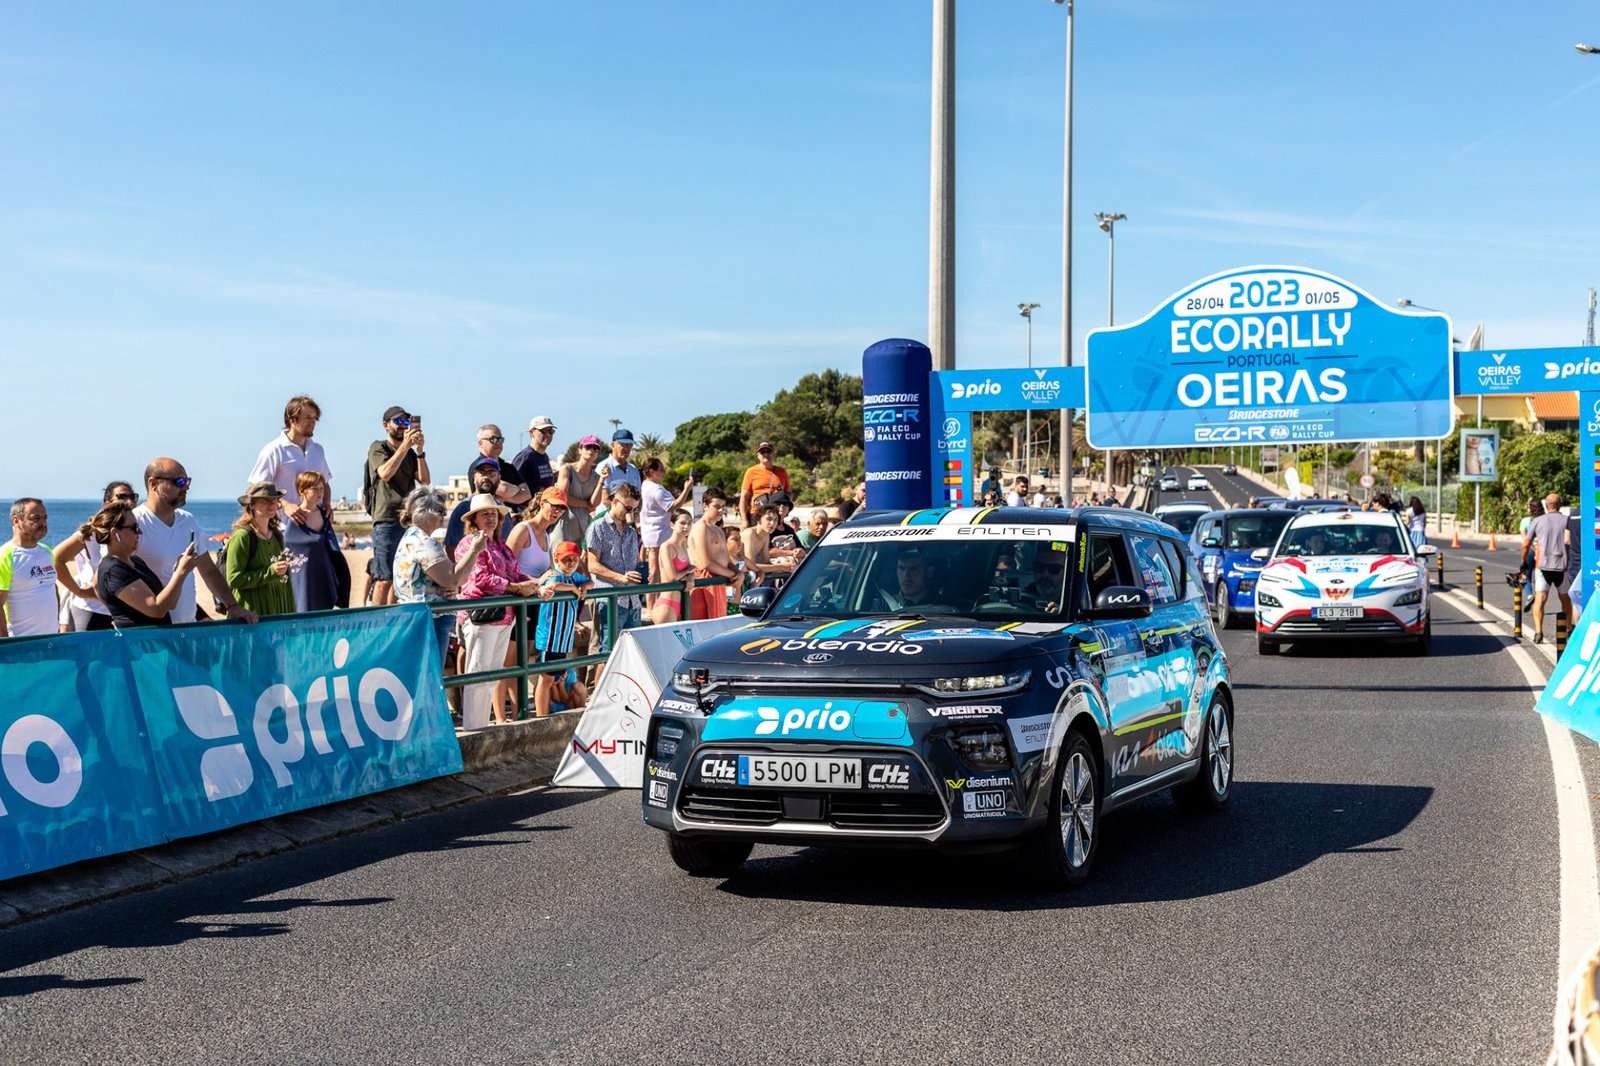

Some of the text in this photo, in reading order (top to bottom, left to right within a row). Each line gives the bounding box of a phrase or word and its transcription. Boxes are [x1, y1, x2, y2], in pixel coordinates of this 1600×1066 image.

[1230, 279, 1300, 308] 2023
[1305, 291, 1340, 305] 01/05
[1187, 298, 1224, 310] 28/04
[1171, 312, 1352, 353] ECORALLY
[1228, 353, 1299, 367] PORTUGAL
[1478, 365, 1521, 376] OEIRAS
[1561, 357, 1600, 379] prio
[1022, 381, 1060, 391] OEIRAS
[1478, 375, 1521, 386] VALLEY
[966, 379, 1001, 398] prio
[1022, 390, 1060, 400] VALLEY
[1177, 368, 1347, 408] OEIRAS
[1228, 408, 1300, 420] BRIDGESTONE
[842, 527, 938, 540] BRIDGESTONE
[782, 639, 923, 655] blendio
[807, 653, 828, 661] KIA
[253, 638, 413, 789] prio
[782, 701, 850, 735] prio
[754, 761, 856, 783] 5500 LPM
[976, 793, 1002, 808] UNO
